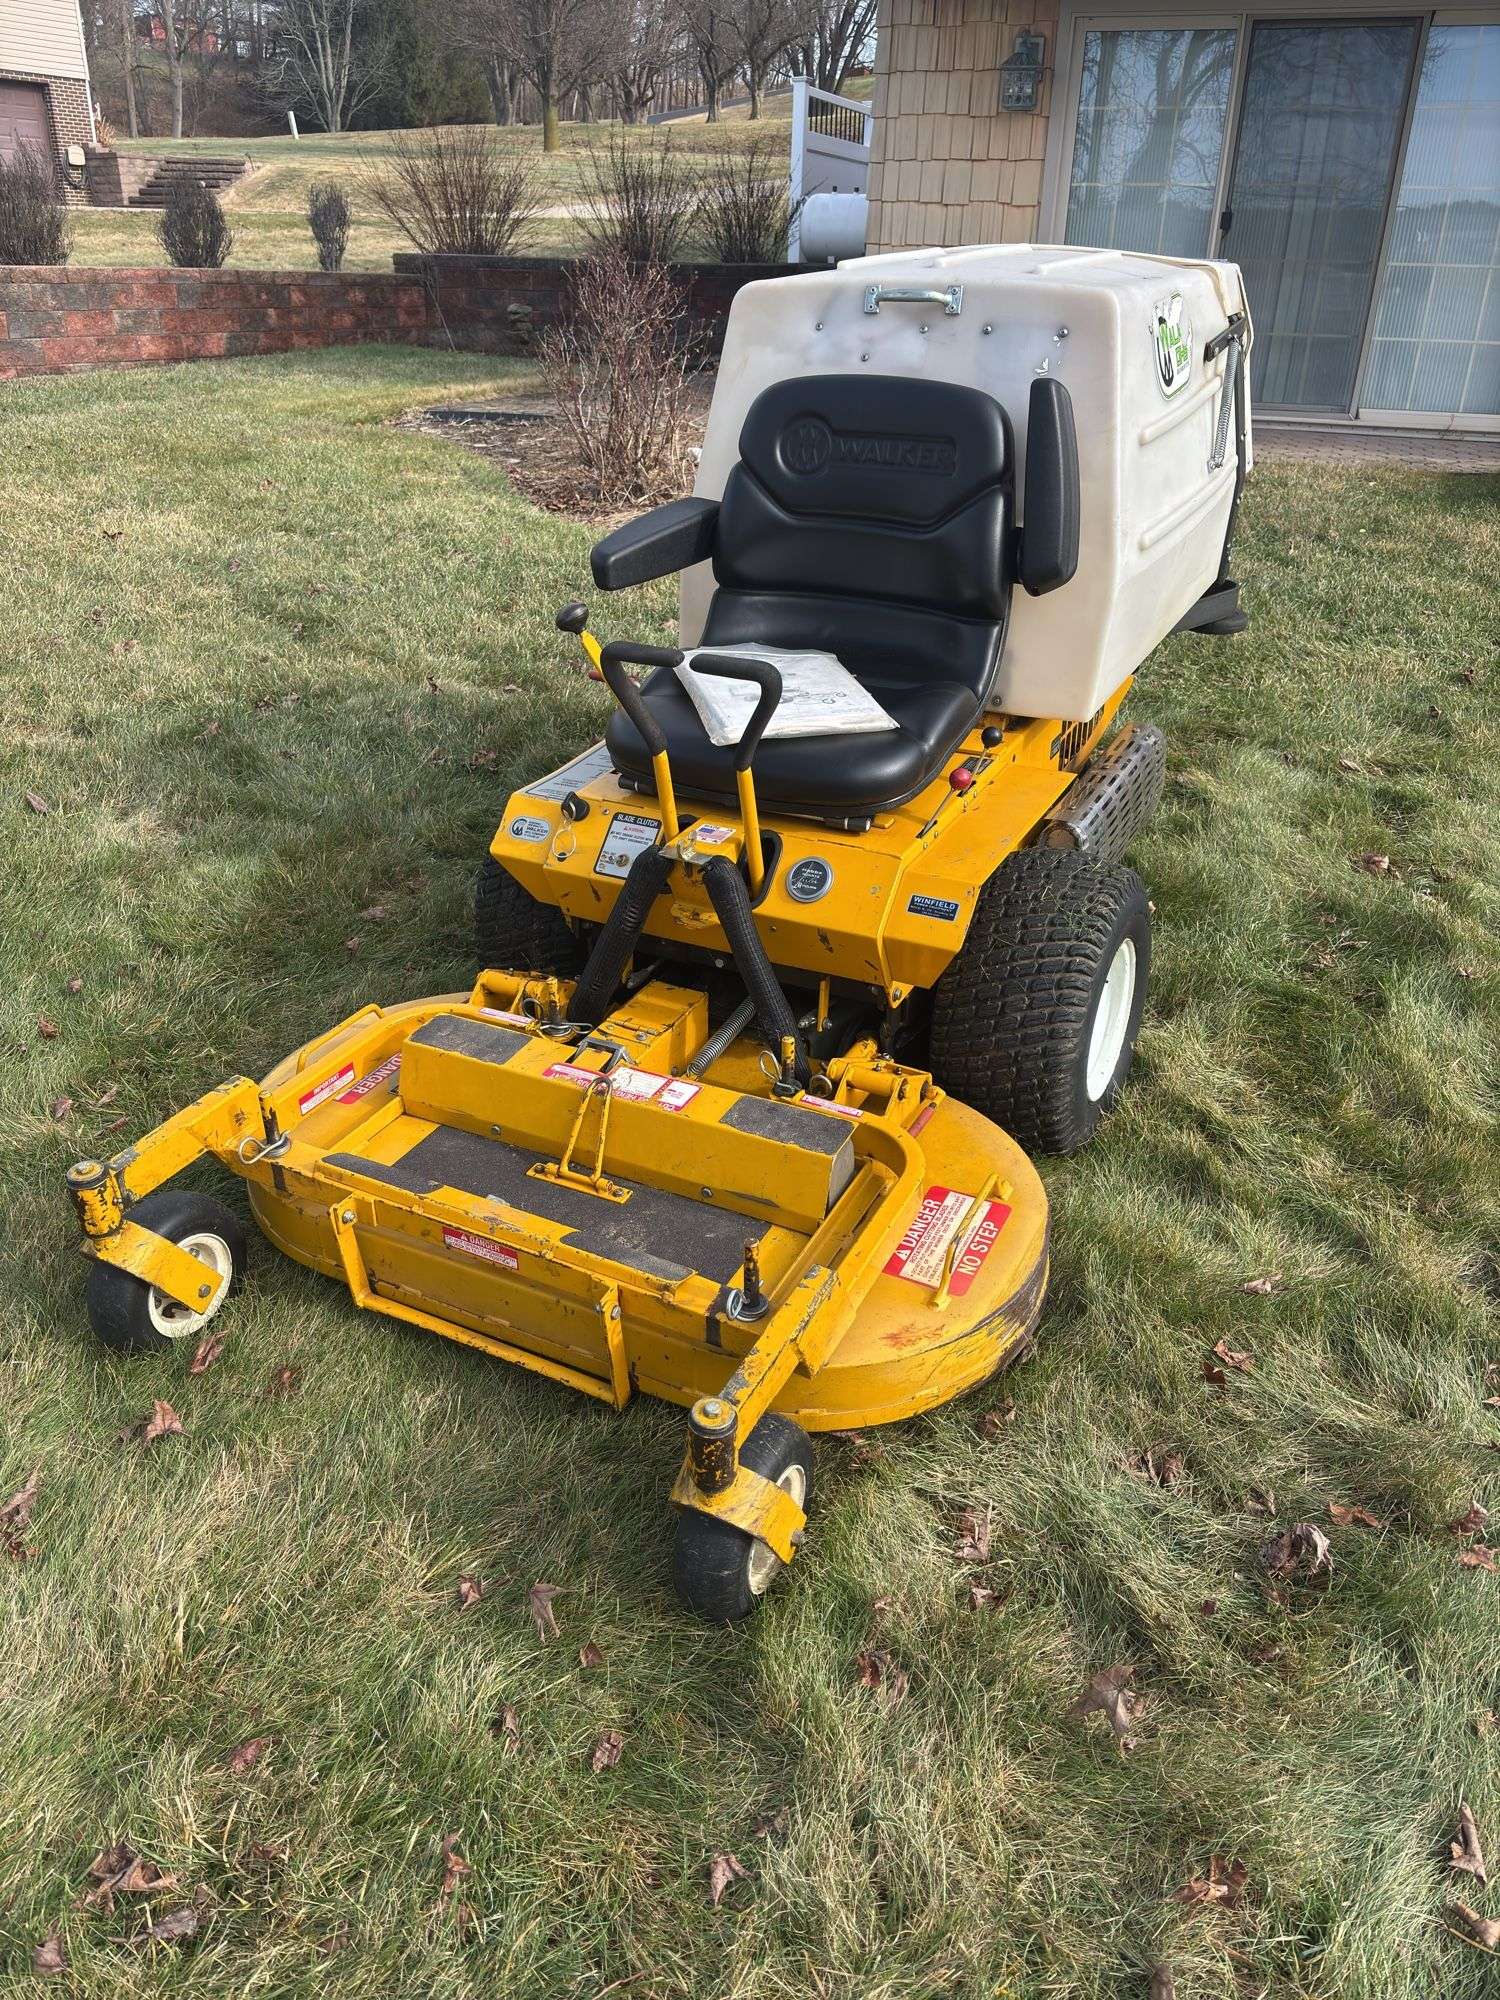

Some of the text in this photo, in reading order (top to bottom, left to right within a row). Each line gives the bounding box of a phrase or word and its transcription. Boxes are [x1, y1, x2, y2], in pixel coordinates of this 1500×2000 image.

[839, 439, 950, 467] WALKER
[617, 813, 659, 827] BLADE CLUTCH
[914, 896, 956, 910] WINFIELD
[353, 1055, 401, 1094] DANGER
[905, 1198, 942, 1247] DANGER
[469, 1236, 501, 1253] DANGER
[957, 1255, 981, 1275] NO
[970, 1221, 999, 1253] STEP
